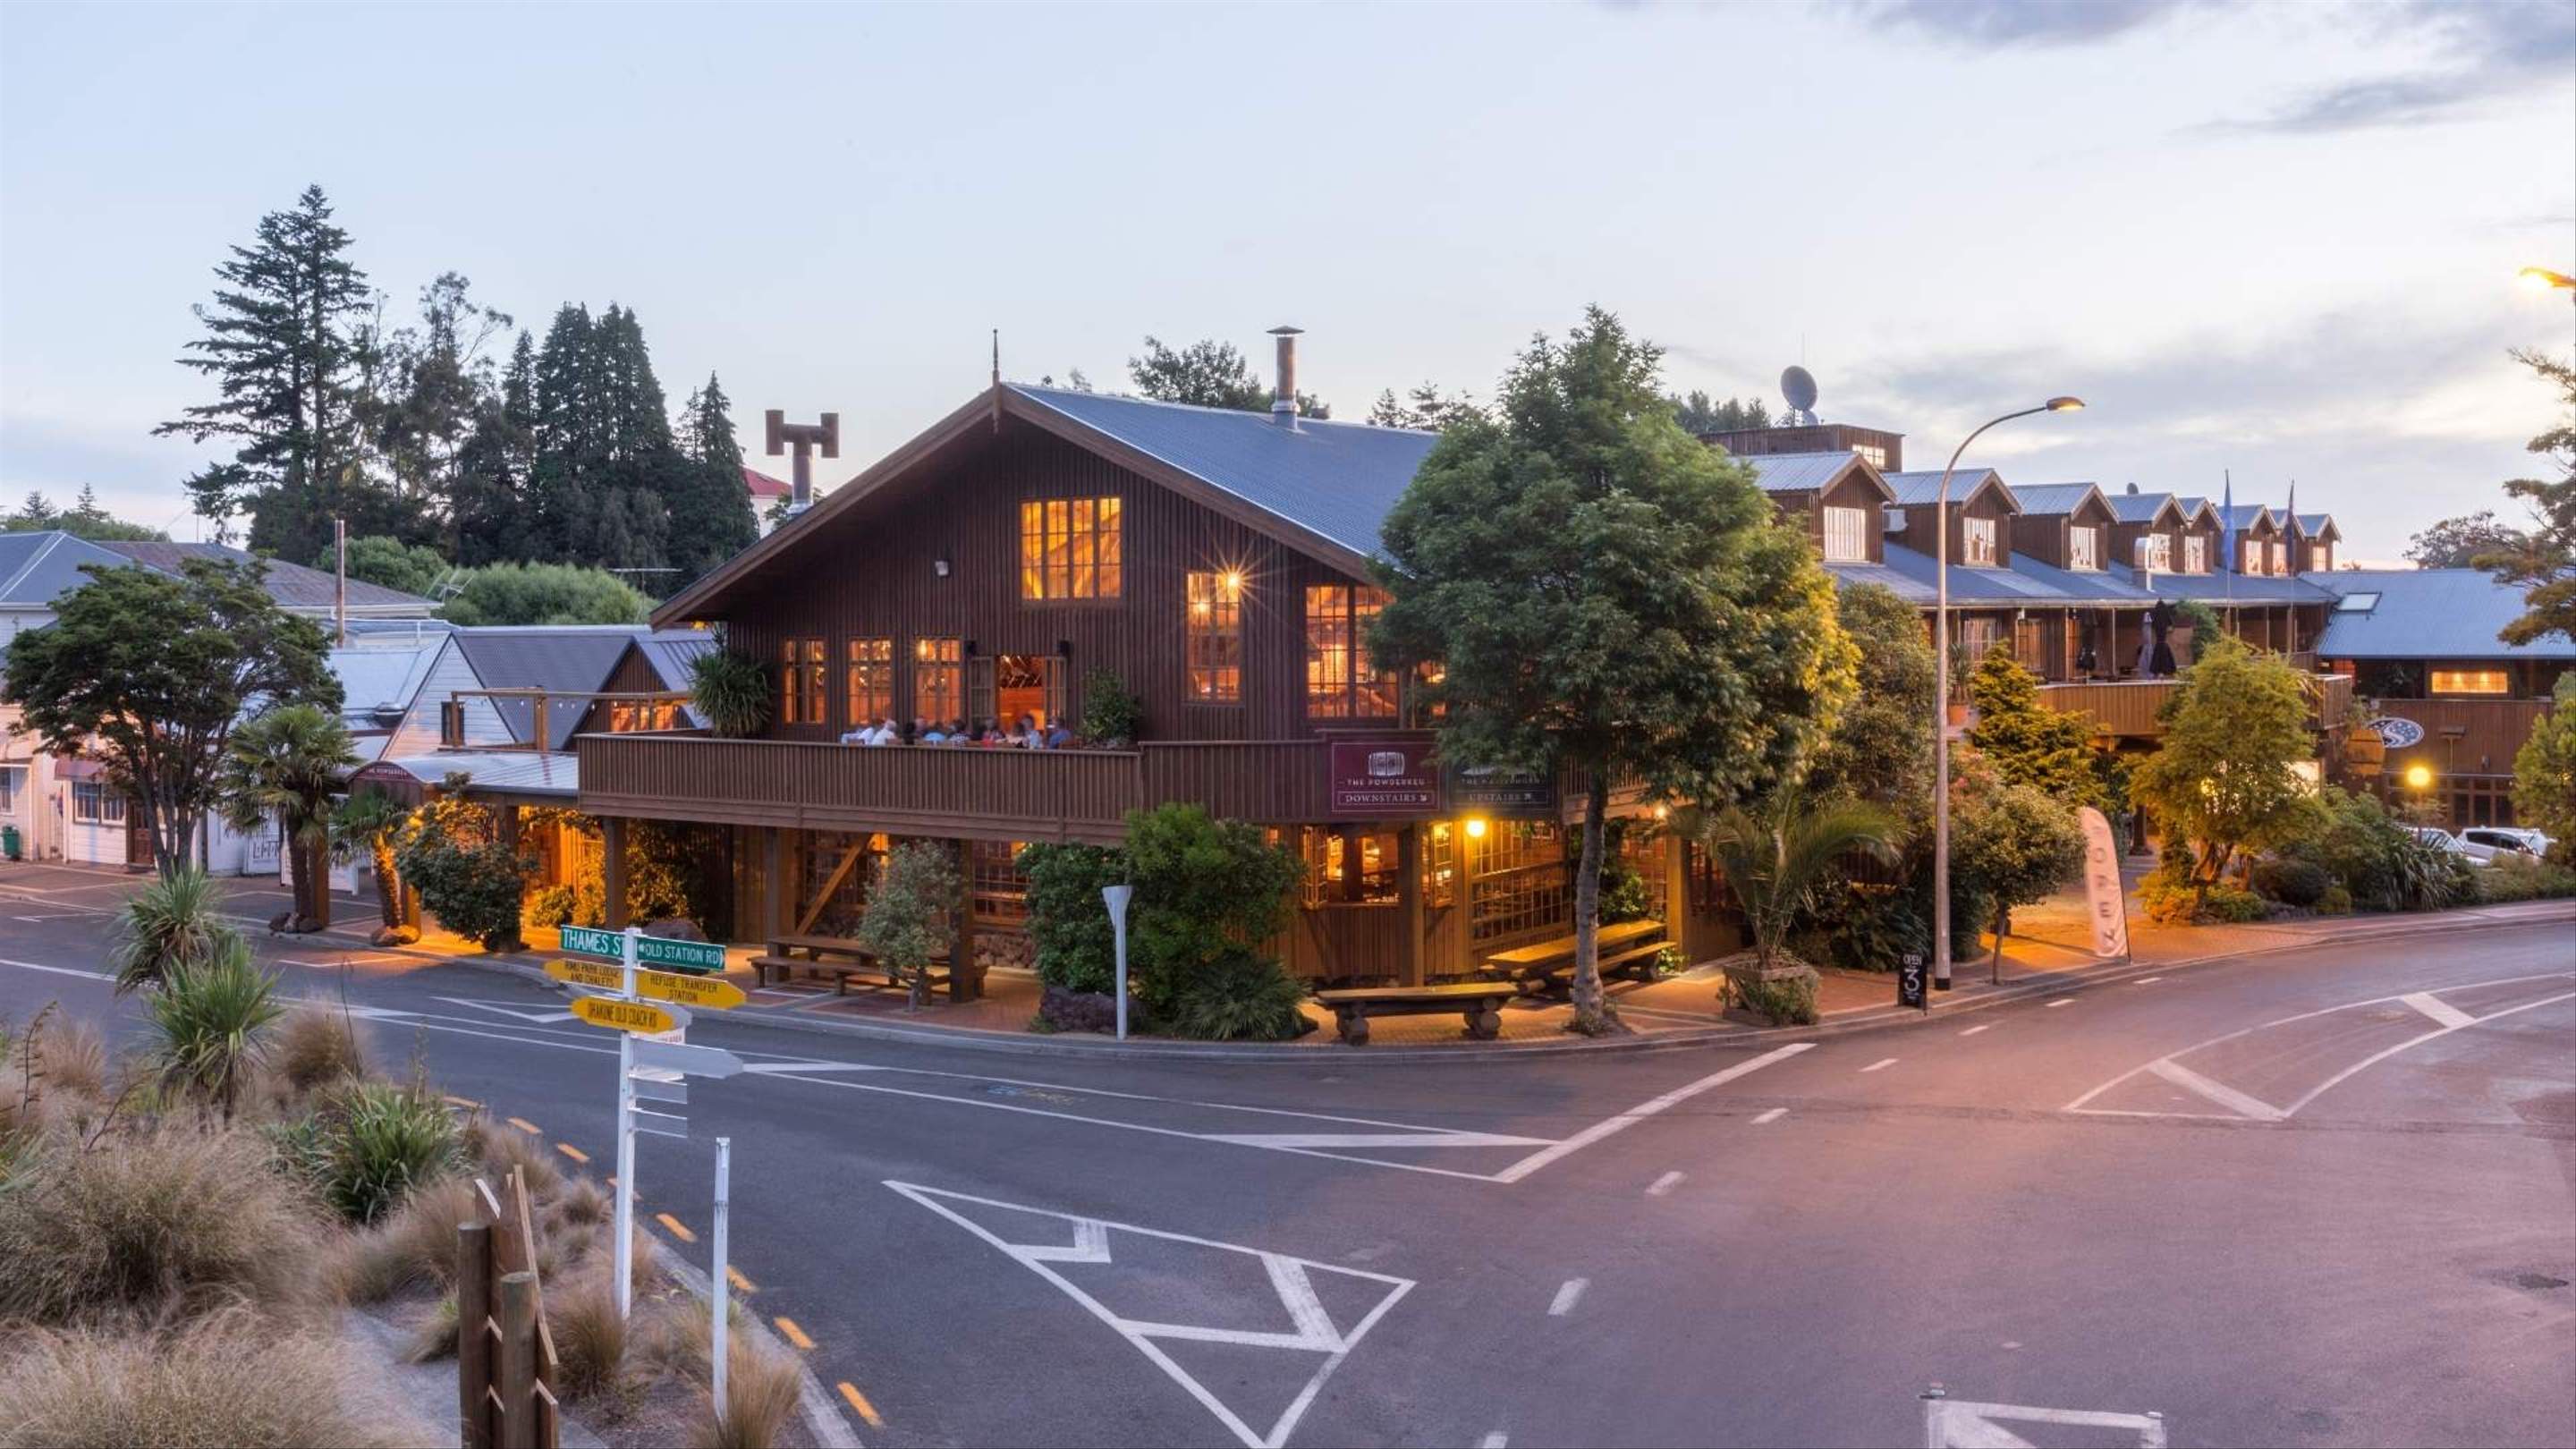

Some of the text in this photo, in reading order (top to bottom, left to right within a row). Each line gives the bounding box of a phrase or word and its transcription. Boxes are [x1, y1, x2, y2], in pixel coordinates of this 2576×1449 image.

[1345, 793, 1417, 802] DOWNSTAIRS
[1469, 793, 1521, 802] UPSTAIRS
[563, 928, 609, 953] THAMES
[645, 944, 719, 966] OLD STATION RD
[649, 974, 718, 994] REFUSE TRANSFER
[669, 988, 699, 1003] STATION
[628, 1007, 649, 1027] COACH
